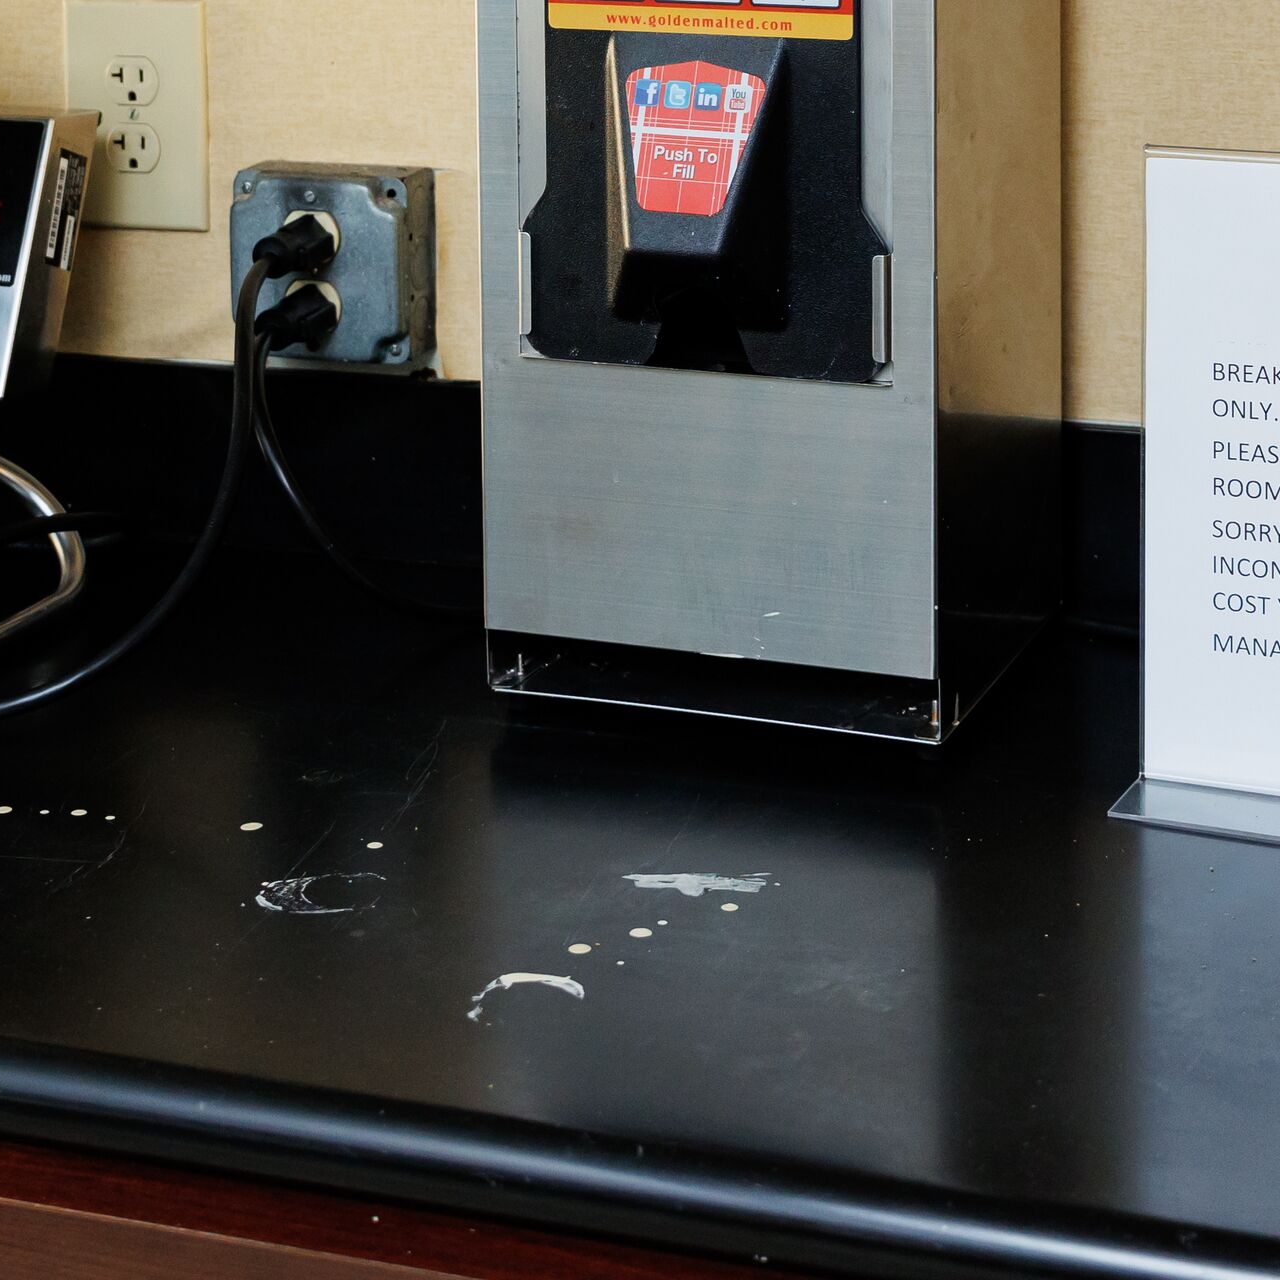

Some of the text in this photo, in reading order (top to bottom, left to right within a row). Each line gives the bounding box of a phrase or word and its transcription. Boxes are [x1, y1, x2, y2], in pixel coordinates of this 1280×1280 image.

[606, 14, 793, 31] www.goldenmalted.com
[731, 88, 746, 100] You
[653, 145, 718, 164] Push To
[672, 164, 695, 179] Fill
[1212, 398, 1279, 422] ONLY.
[1212, 592, 1272, 616] COST
